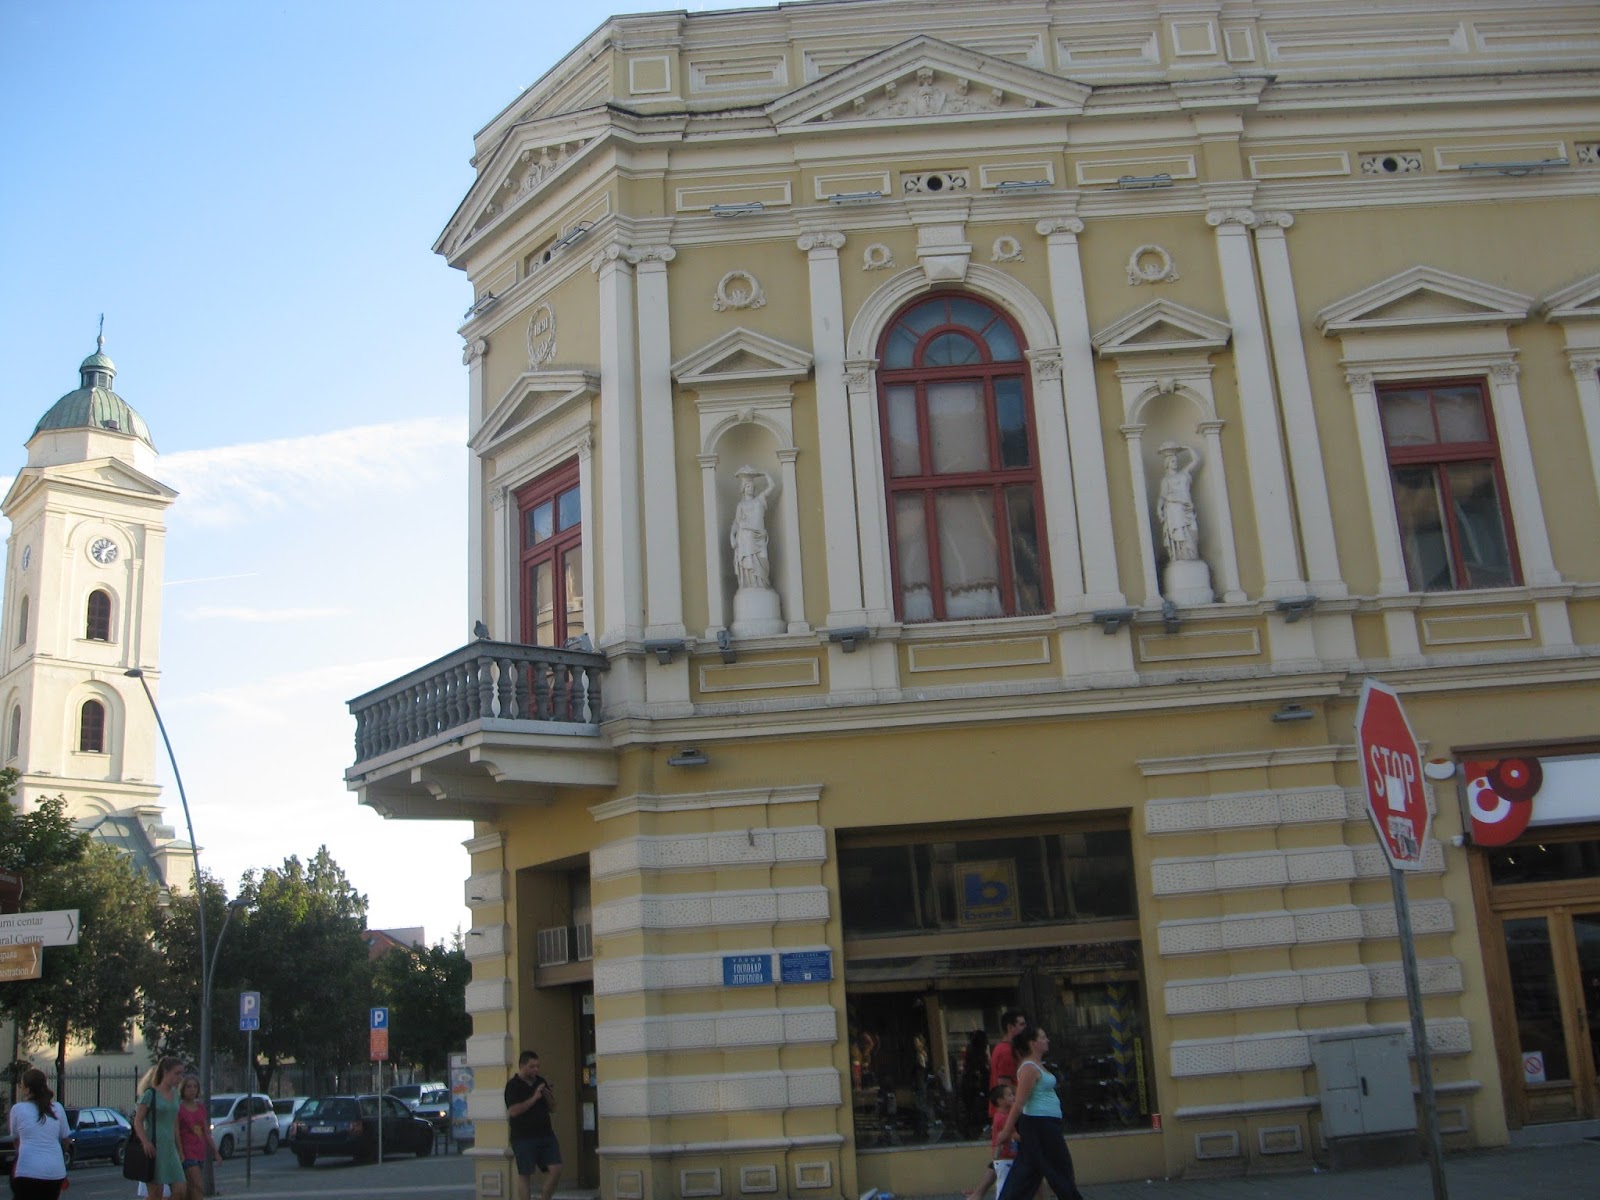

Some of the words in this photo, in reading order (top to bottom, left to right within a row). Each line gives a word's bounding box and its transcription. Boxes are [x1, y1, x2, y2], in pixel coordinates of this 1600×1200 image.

[1371, 744, 1415, 804] STOP
[17, 917, 44, 927] centar
[15, 934, 44, 945] Centre
[244, 996, 255, 1015] P
[374, 1010, 384, 1026] P
